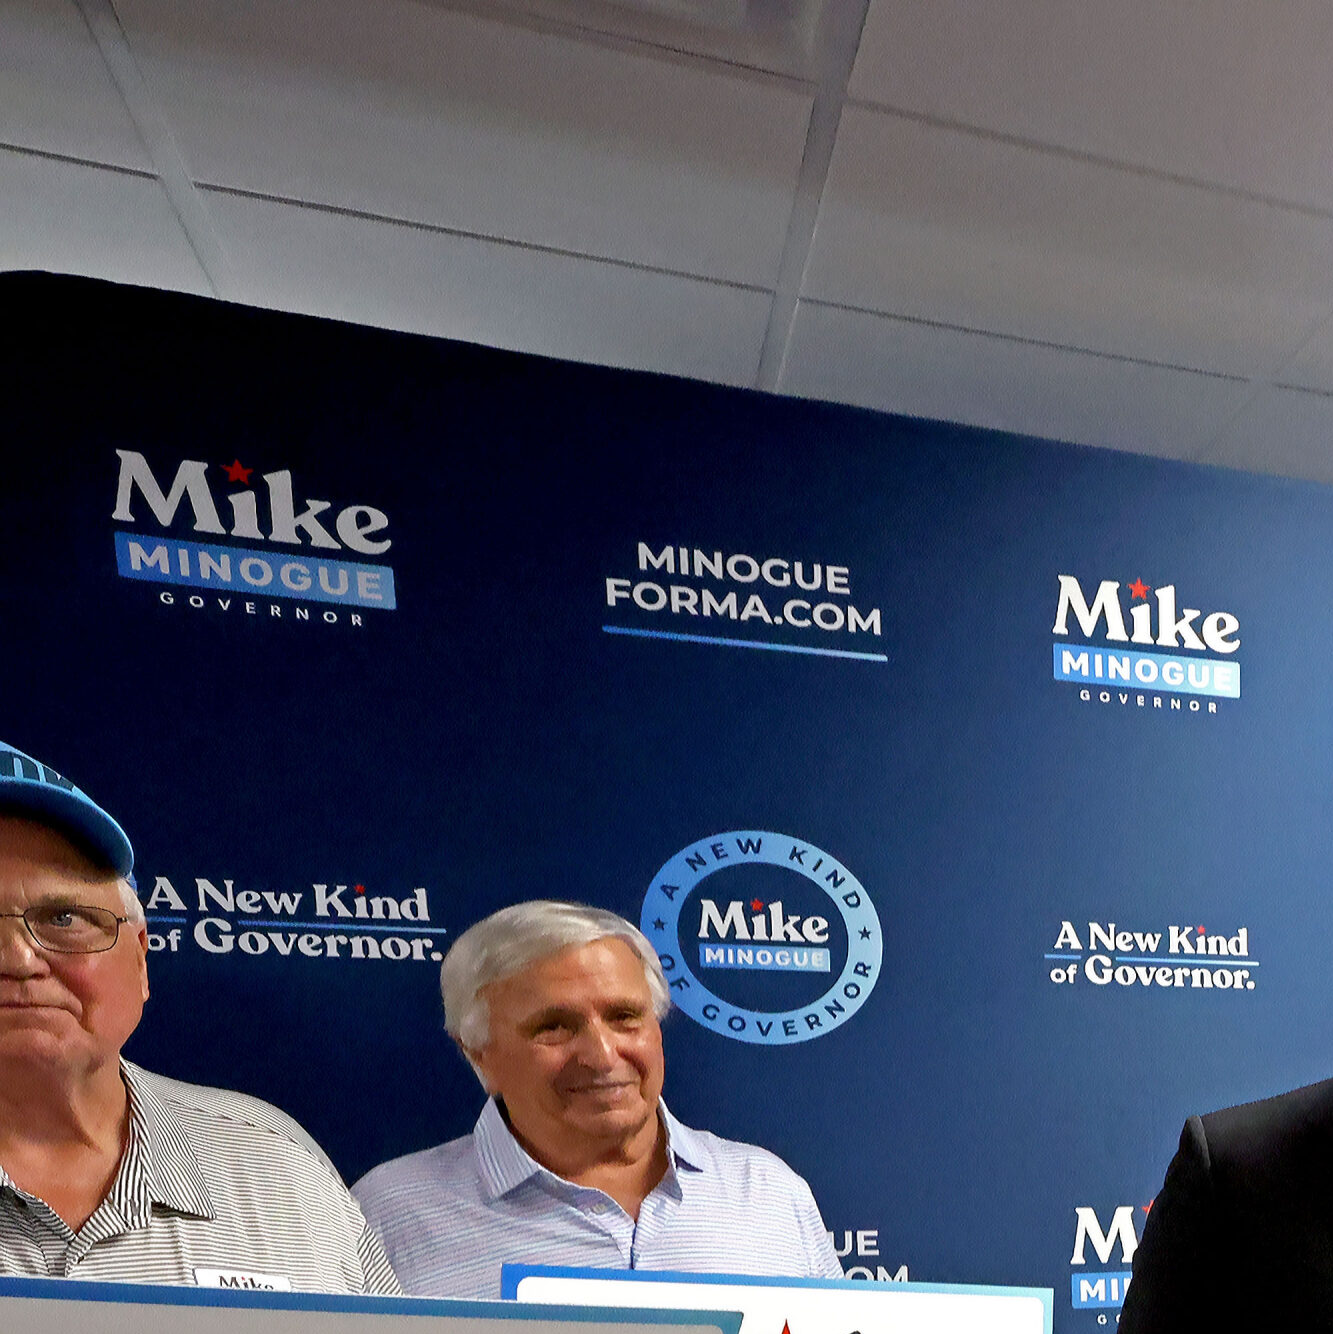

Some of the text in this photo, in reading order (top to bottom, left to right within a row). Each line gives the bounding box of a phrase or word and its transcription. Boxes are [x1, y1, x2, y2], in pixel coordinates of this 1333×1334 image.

[112, 449, 392, 555] Mike
[127, 542, 384, 600] MINOGUE
[636, 542, 851, 595] MINOGUE
[160, 591, 364, 626] GOVERNOR
[606, 578, 882, 636] FORMA.COM
[1052, 575, 1241, 654] Mike
[1062, 650, 1233, 691] MINOGUE
[1079, 689, 1218, 714] GOVERNOR
[661, 838, 861, 908] A NEW KIND
[147, 876, 431, 921] A New Kind
[698, 898, 829, 944] Mike
[147, 918, 444, 961] of Governor.
[705, 947, 825, 967] MINOGUE
[1055, 922, 1249, 957] A New Kind
[659, 953, 872, 1037] OF GOVERNOR
[1049, 955, 1256, 990] of Governor.
